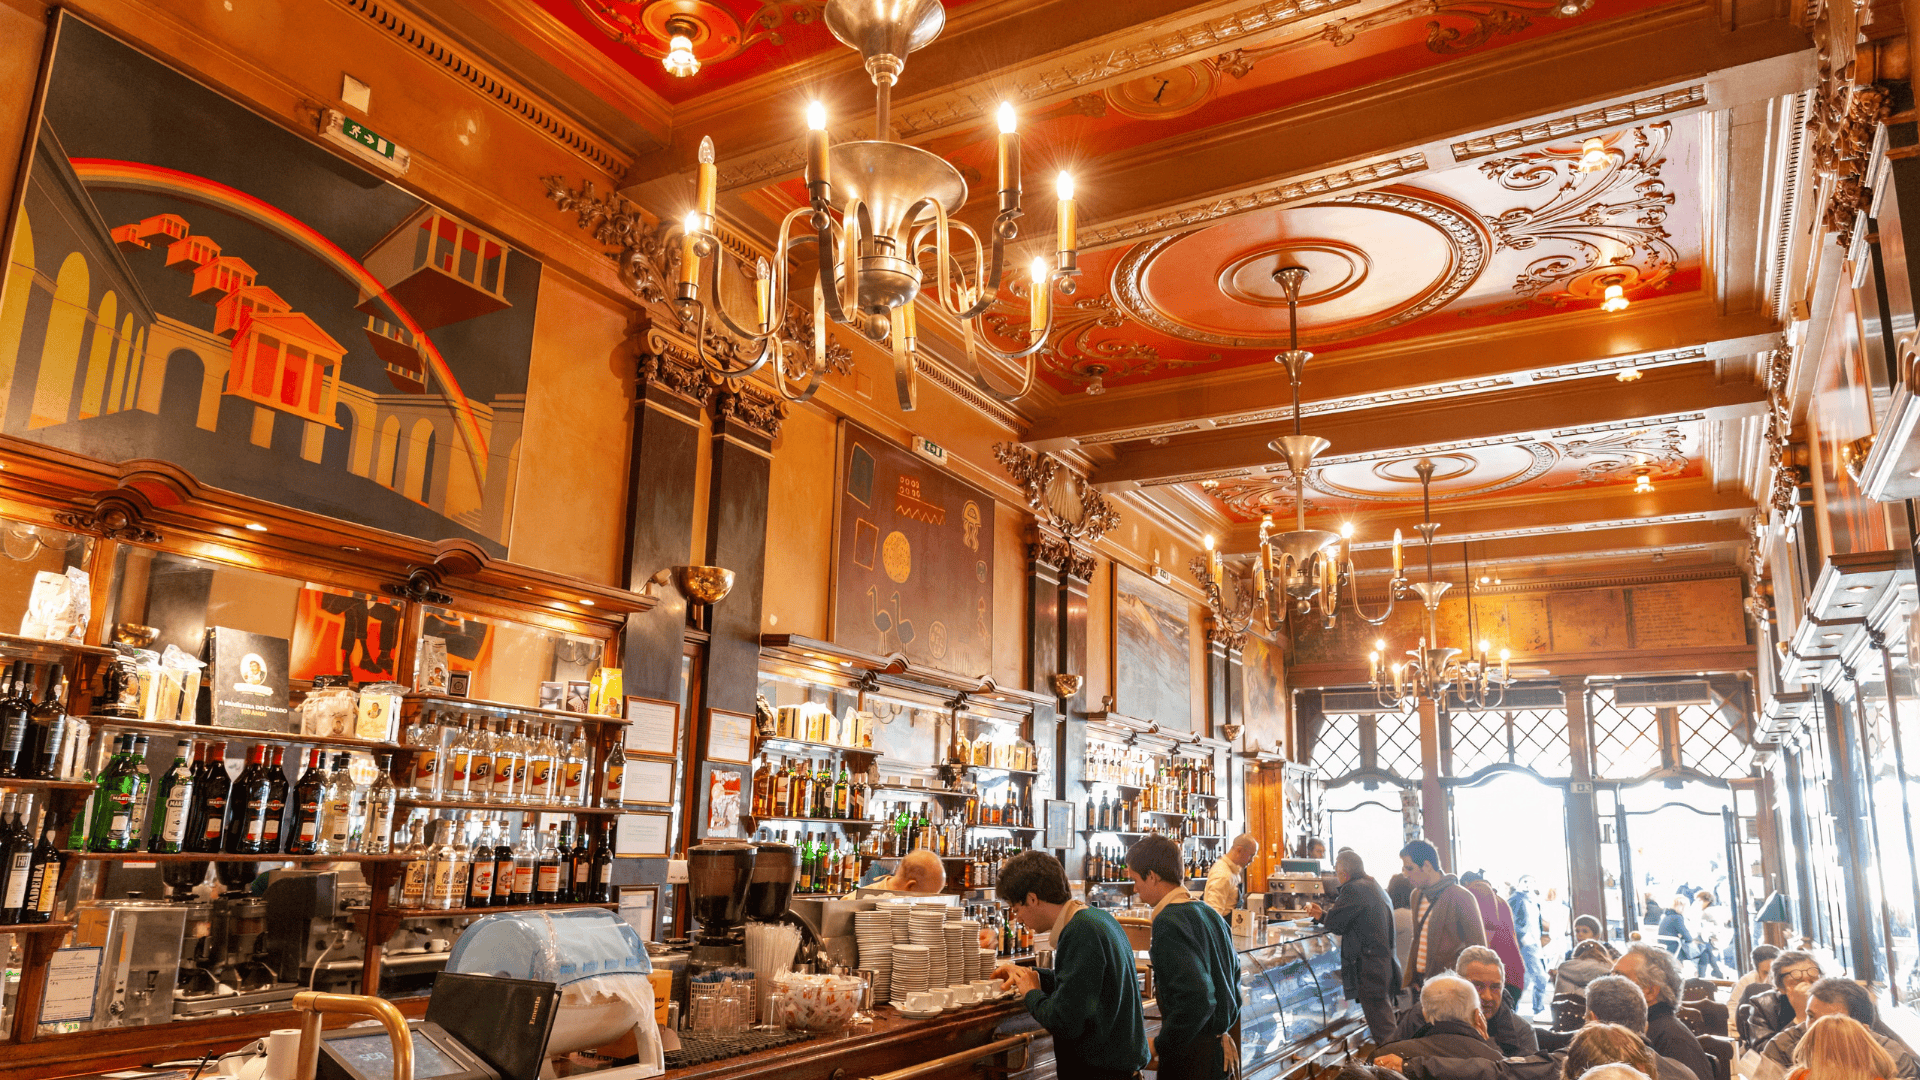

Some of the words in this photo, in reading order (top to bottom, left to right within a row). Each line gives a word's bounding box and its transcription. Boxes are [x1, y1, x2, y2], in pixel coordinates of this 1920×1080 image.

[477, 763, 489, 775] 51
[26, 863, 46, 911] MADEIRA
[528, 996, 541, 1026] Ementa
